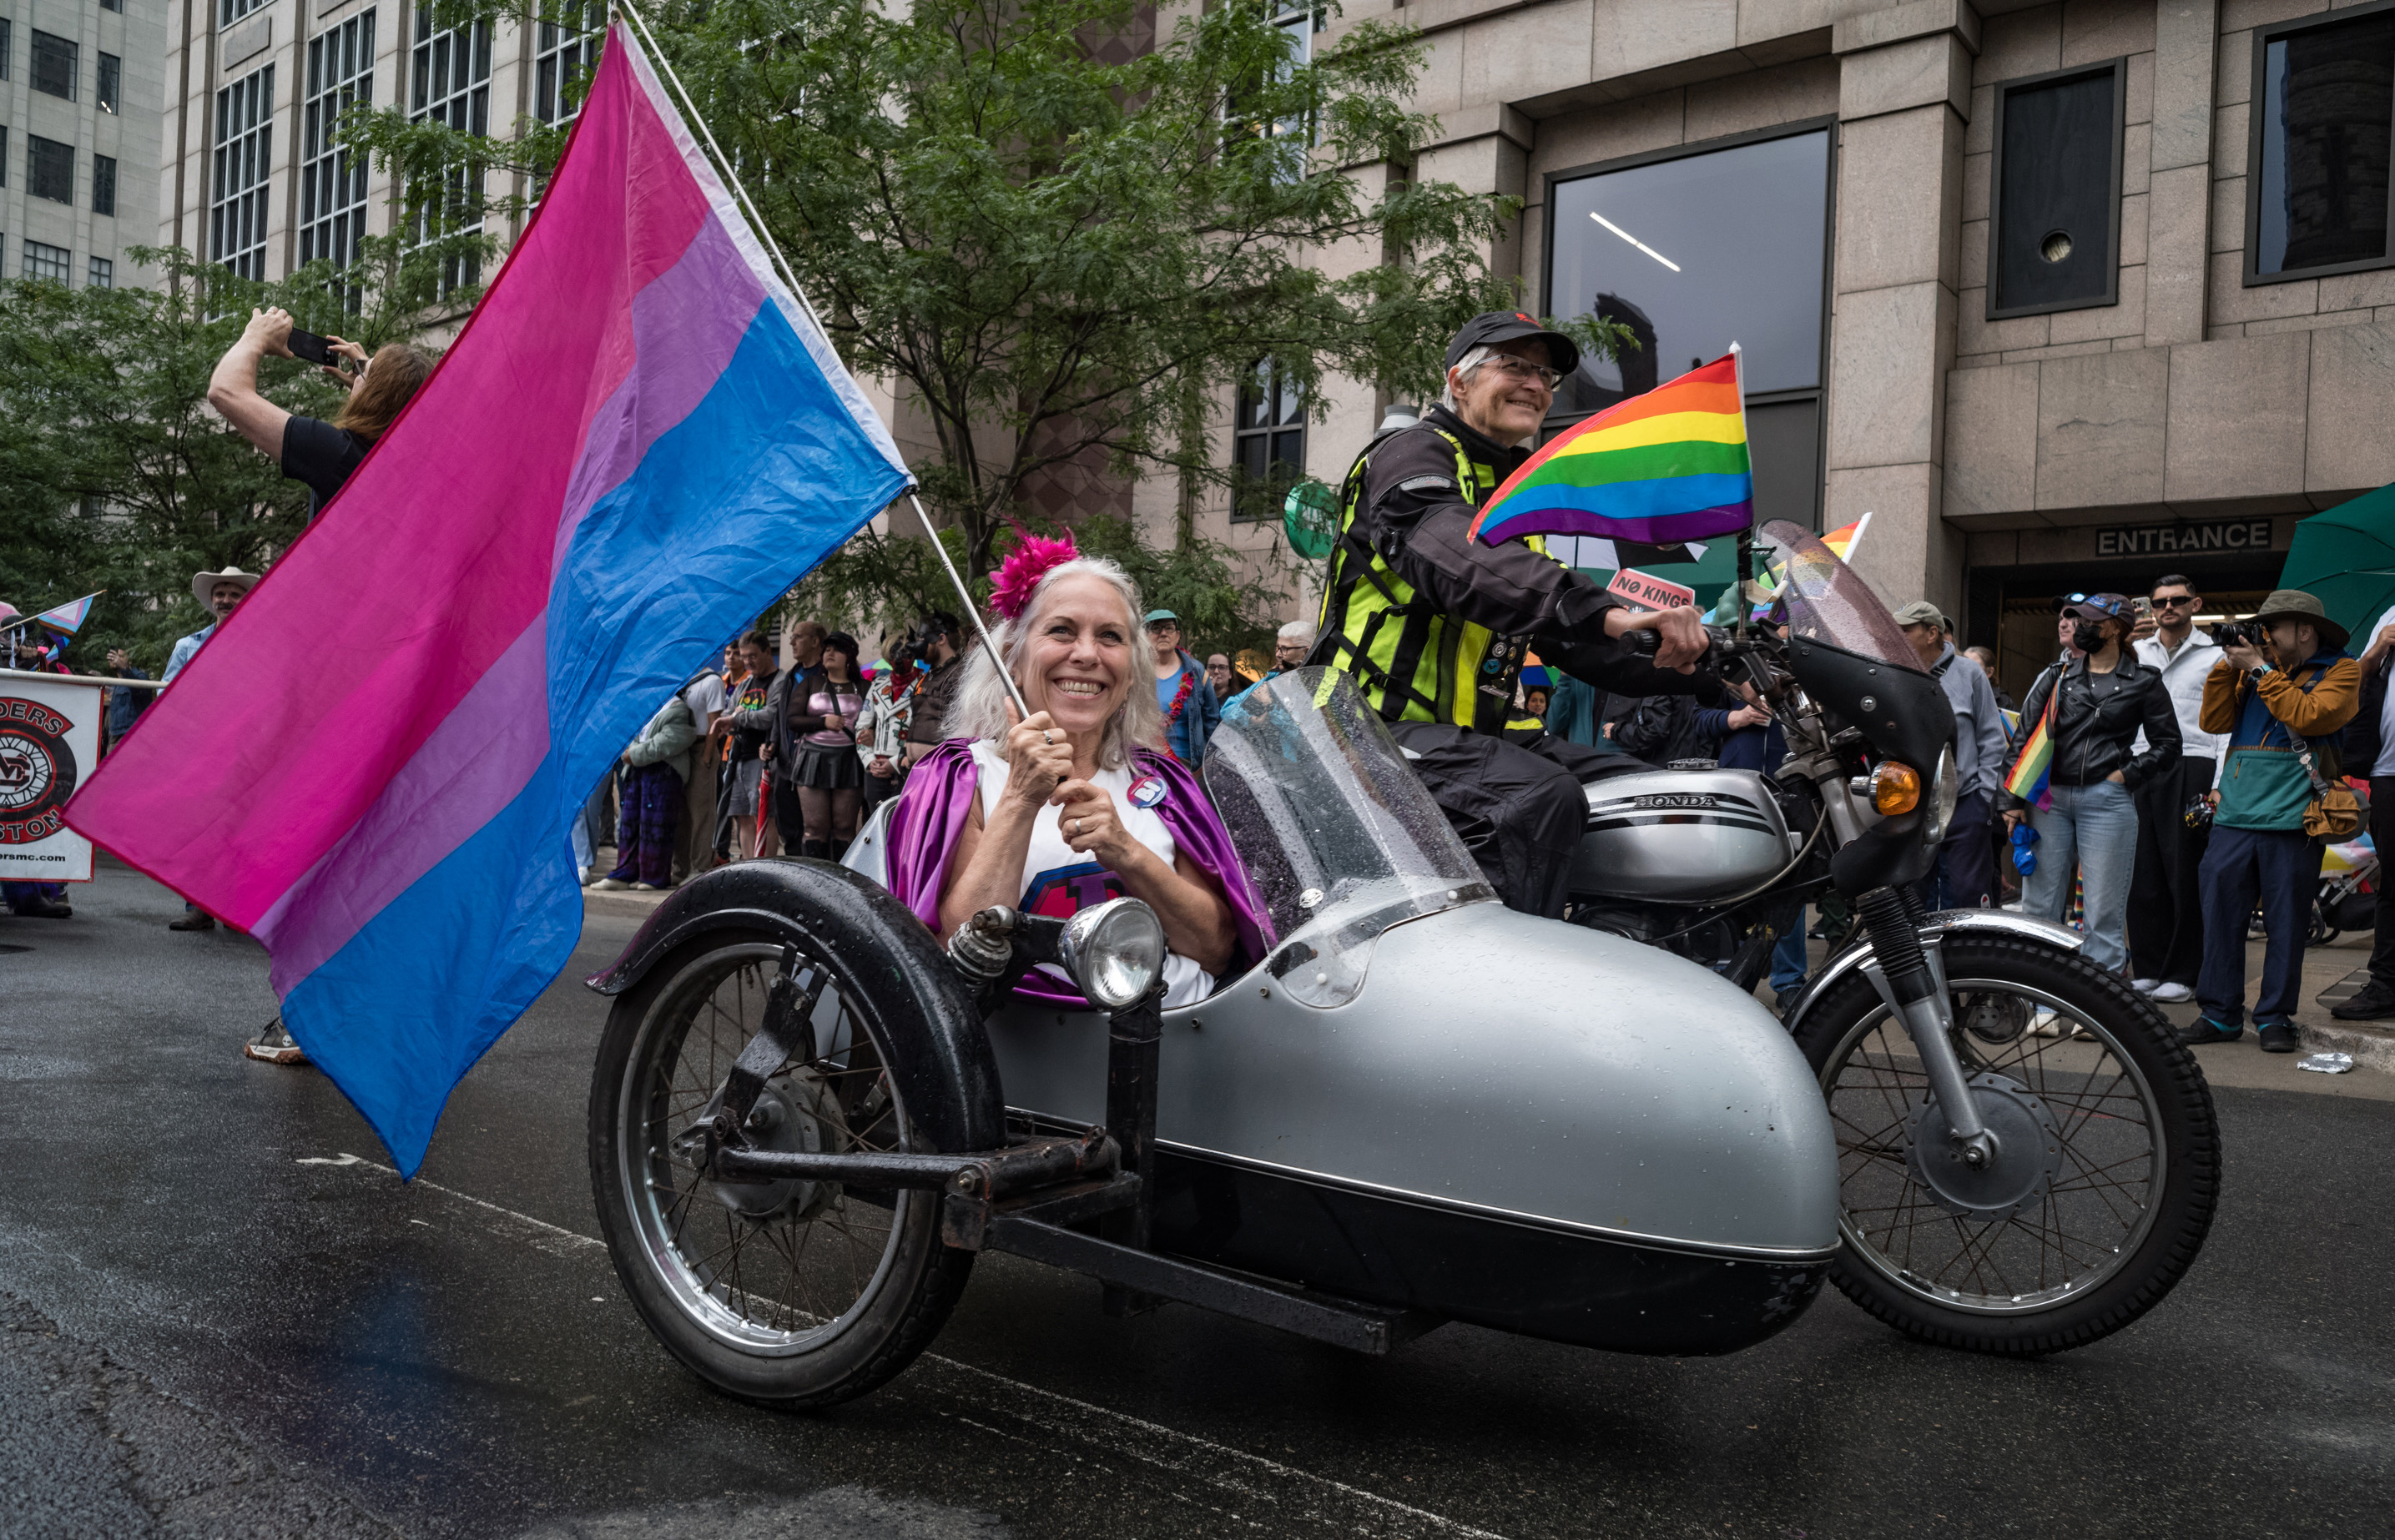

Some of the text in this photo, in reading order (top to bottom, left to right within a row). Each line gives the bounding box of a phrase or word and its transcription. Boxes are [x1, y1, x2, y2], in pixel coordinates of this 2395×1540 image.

[2098, 522, 2269, 554] ENTRANCE
[1134, 781, 1162, 802] BI
[1634, 795, 1720, 808] HONDA
[0, 808, 63, 841] TON
